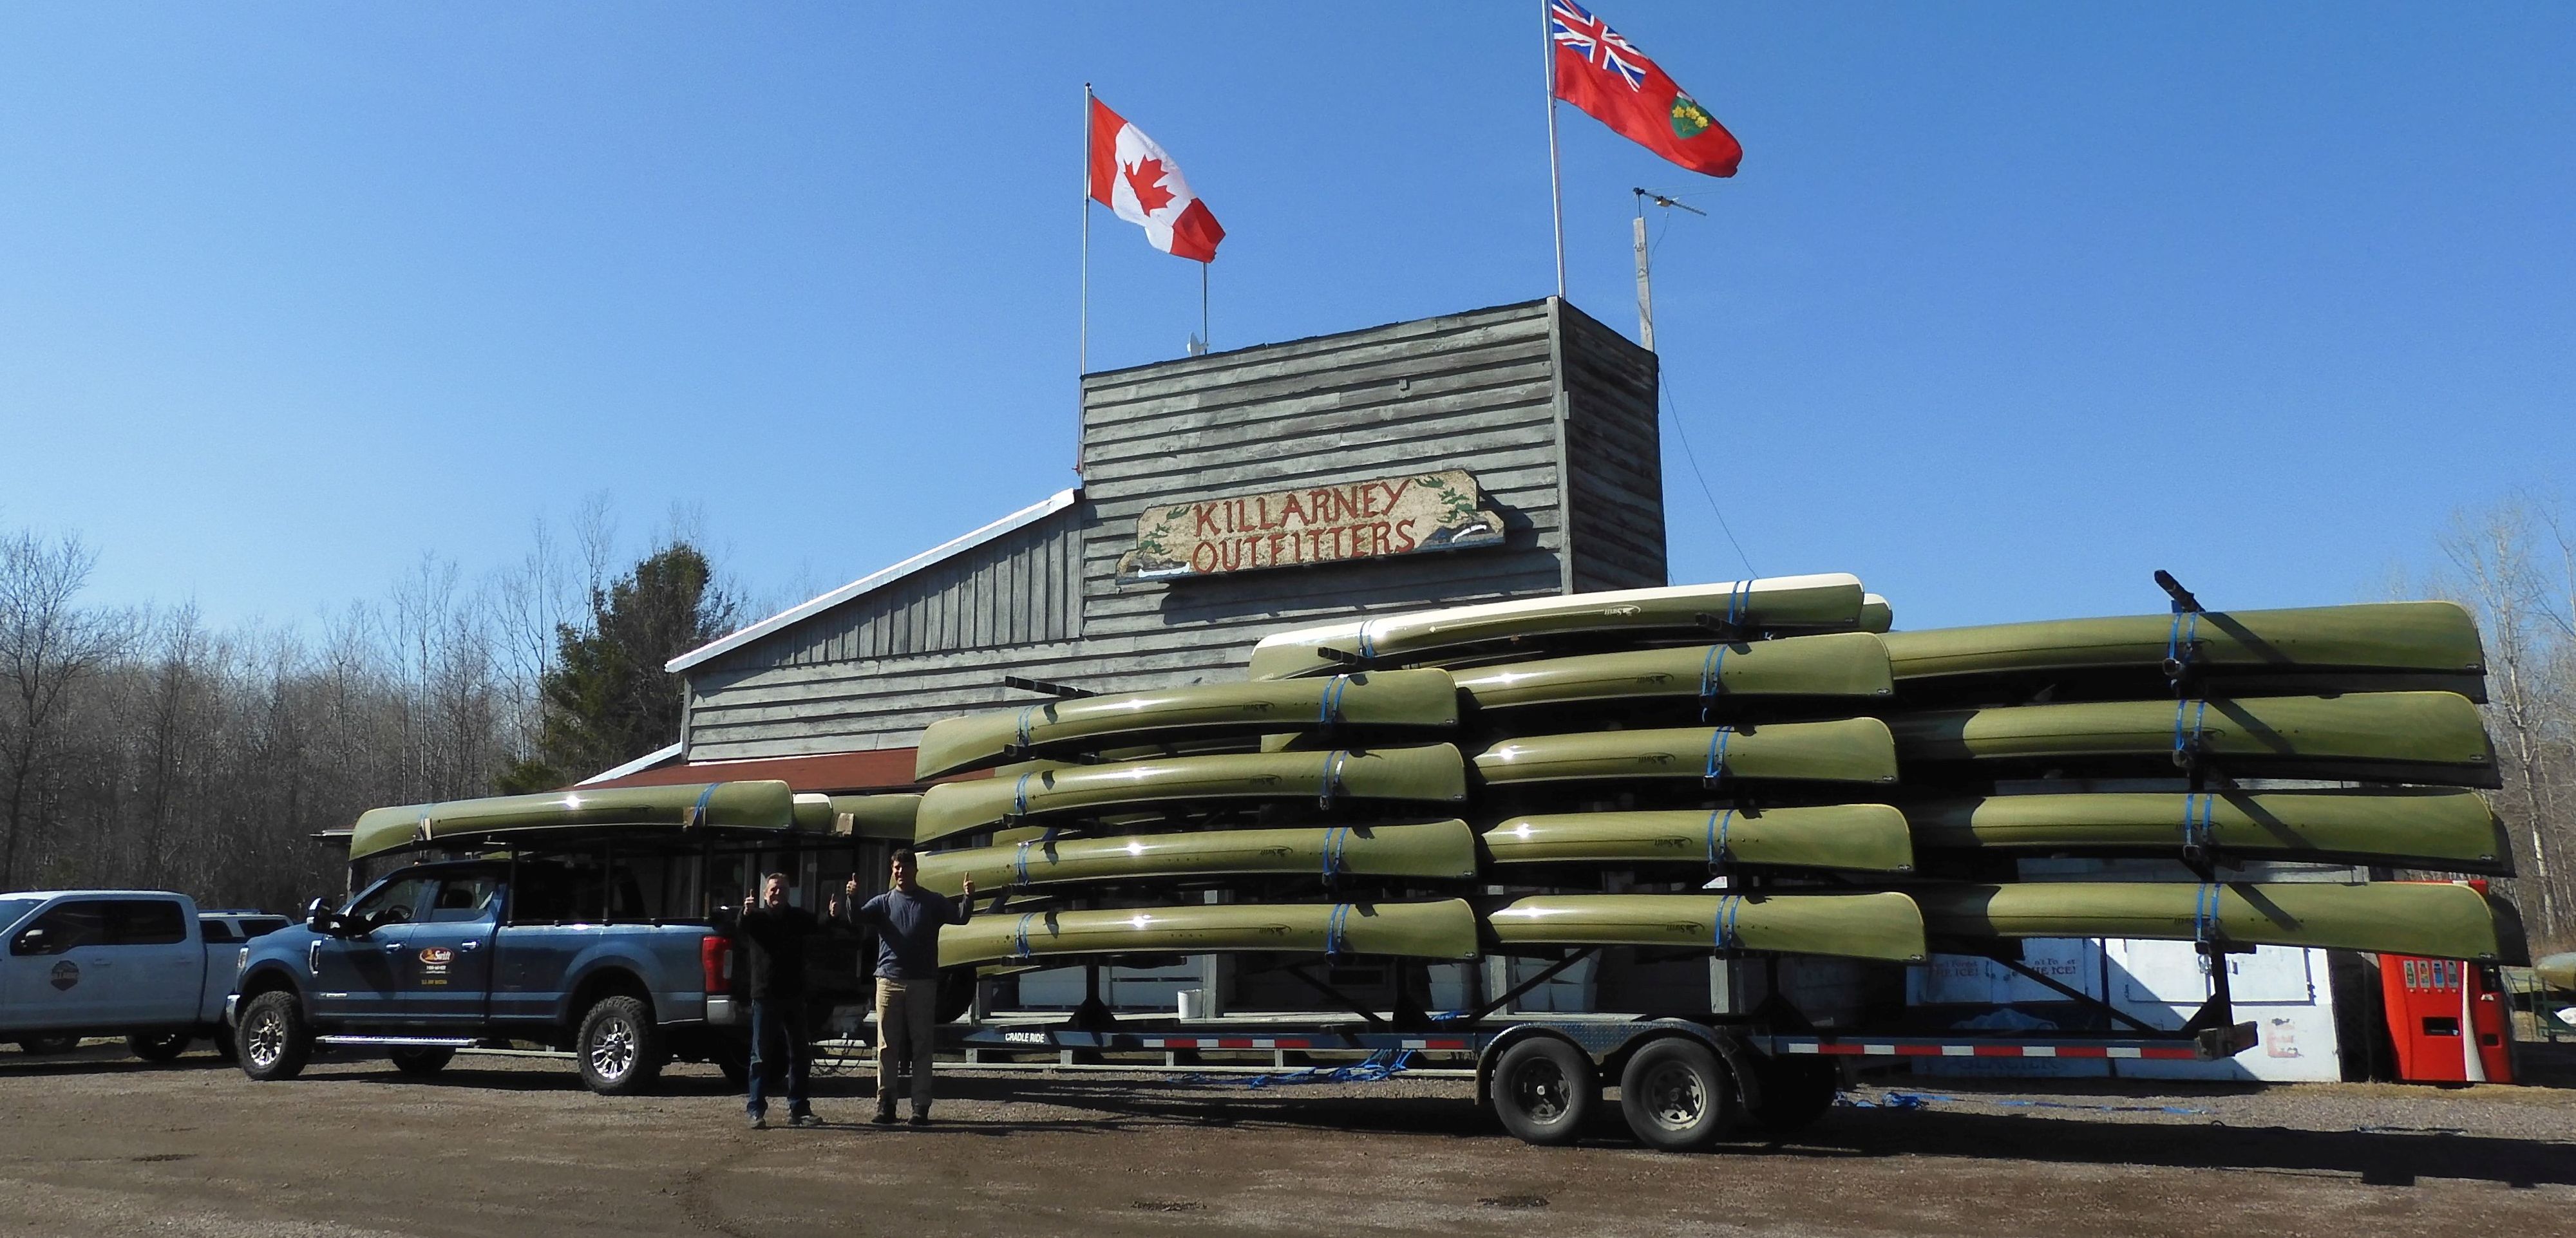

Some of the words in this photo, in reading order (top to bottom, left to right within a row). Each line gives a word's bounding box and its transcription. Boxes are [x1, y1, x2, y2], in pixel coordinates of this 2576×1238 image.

[1193, 478, 1412, 537] KILLARNEY
[1192, 519, 1416, 574] OUTFITTERS
[2051, 966, 2076, 975] ICE!
[1005, 1033, 1028, 1042] CRADLE
[1030, 1033, 1045, 1042] RIDE
